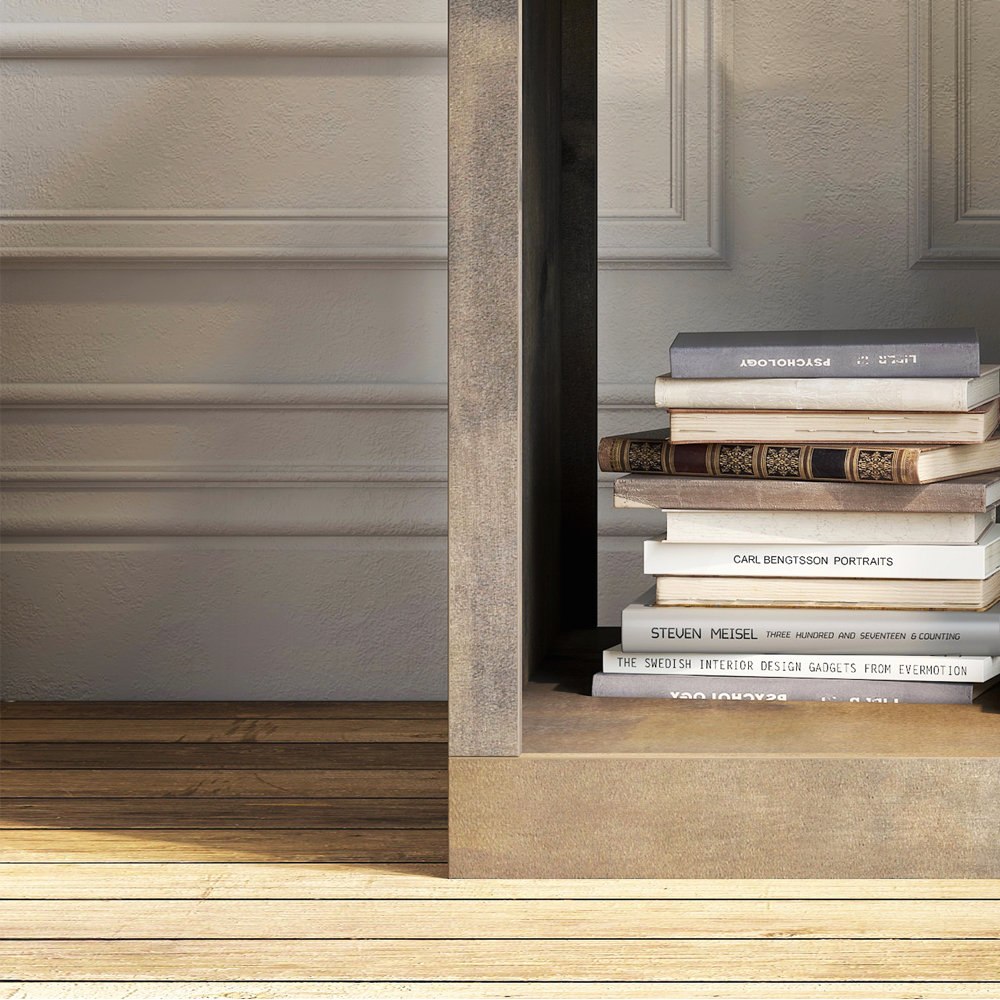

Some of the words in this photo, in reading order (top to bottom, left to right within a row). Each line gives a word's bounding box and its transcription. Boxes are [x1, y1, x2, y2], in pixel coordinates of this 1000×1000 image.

[740, 358, 831, 367] PSYCHOLOGY
[733, 554, 761, 565] CARL
[763, 554, 829, 565] BENGTSSON
[833, 556, 894, 567] PORTRAITS
[651, 627, 702, 640] STEVEN
[710, 628, 758, 640] MEISEL
[765, 630, 791, 639] THREE
[795, 631, 835, 640] HUNDRED
[837, 631, 856, 640] AND
[859, 632, 907, 641] SEVENTEEN
[918, 632, 961, 641] COUNTING
[617, 657, 638, 668] THE
[644, 657, 692, 669] SWEDISH
[699, 659, 754, 671] INTERIOR
[760, 660, 802, 672] DESIGN
[808, 662, 857, 674] GADGETS
[864, 663, 892, 674] FROM
[899, 664, 968, 676] EVERMOTION
